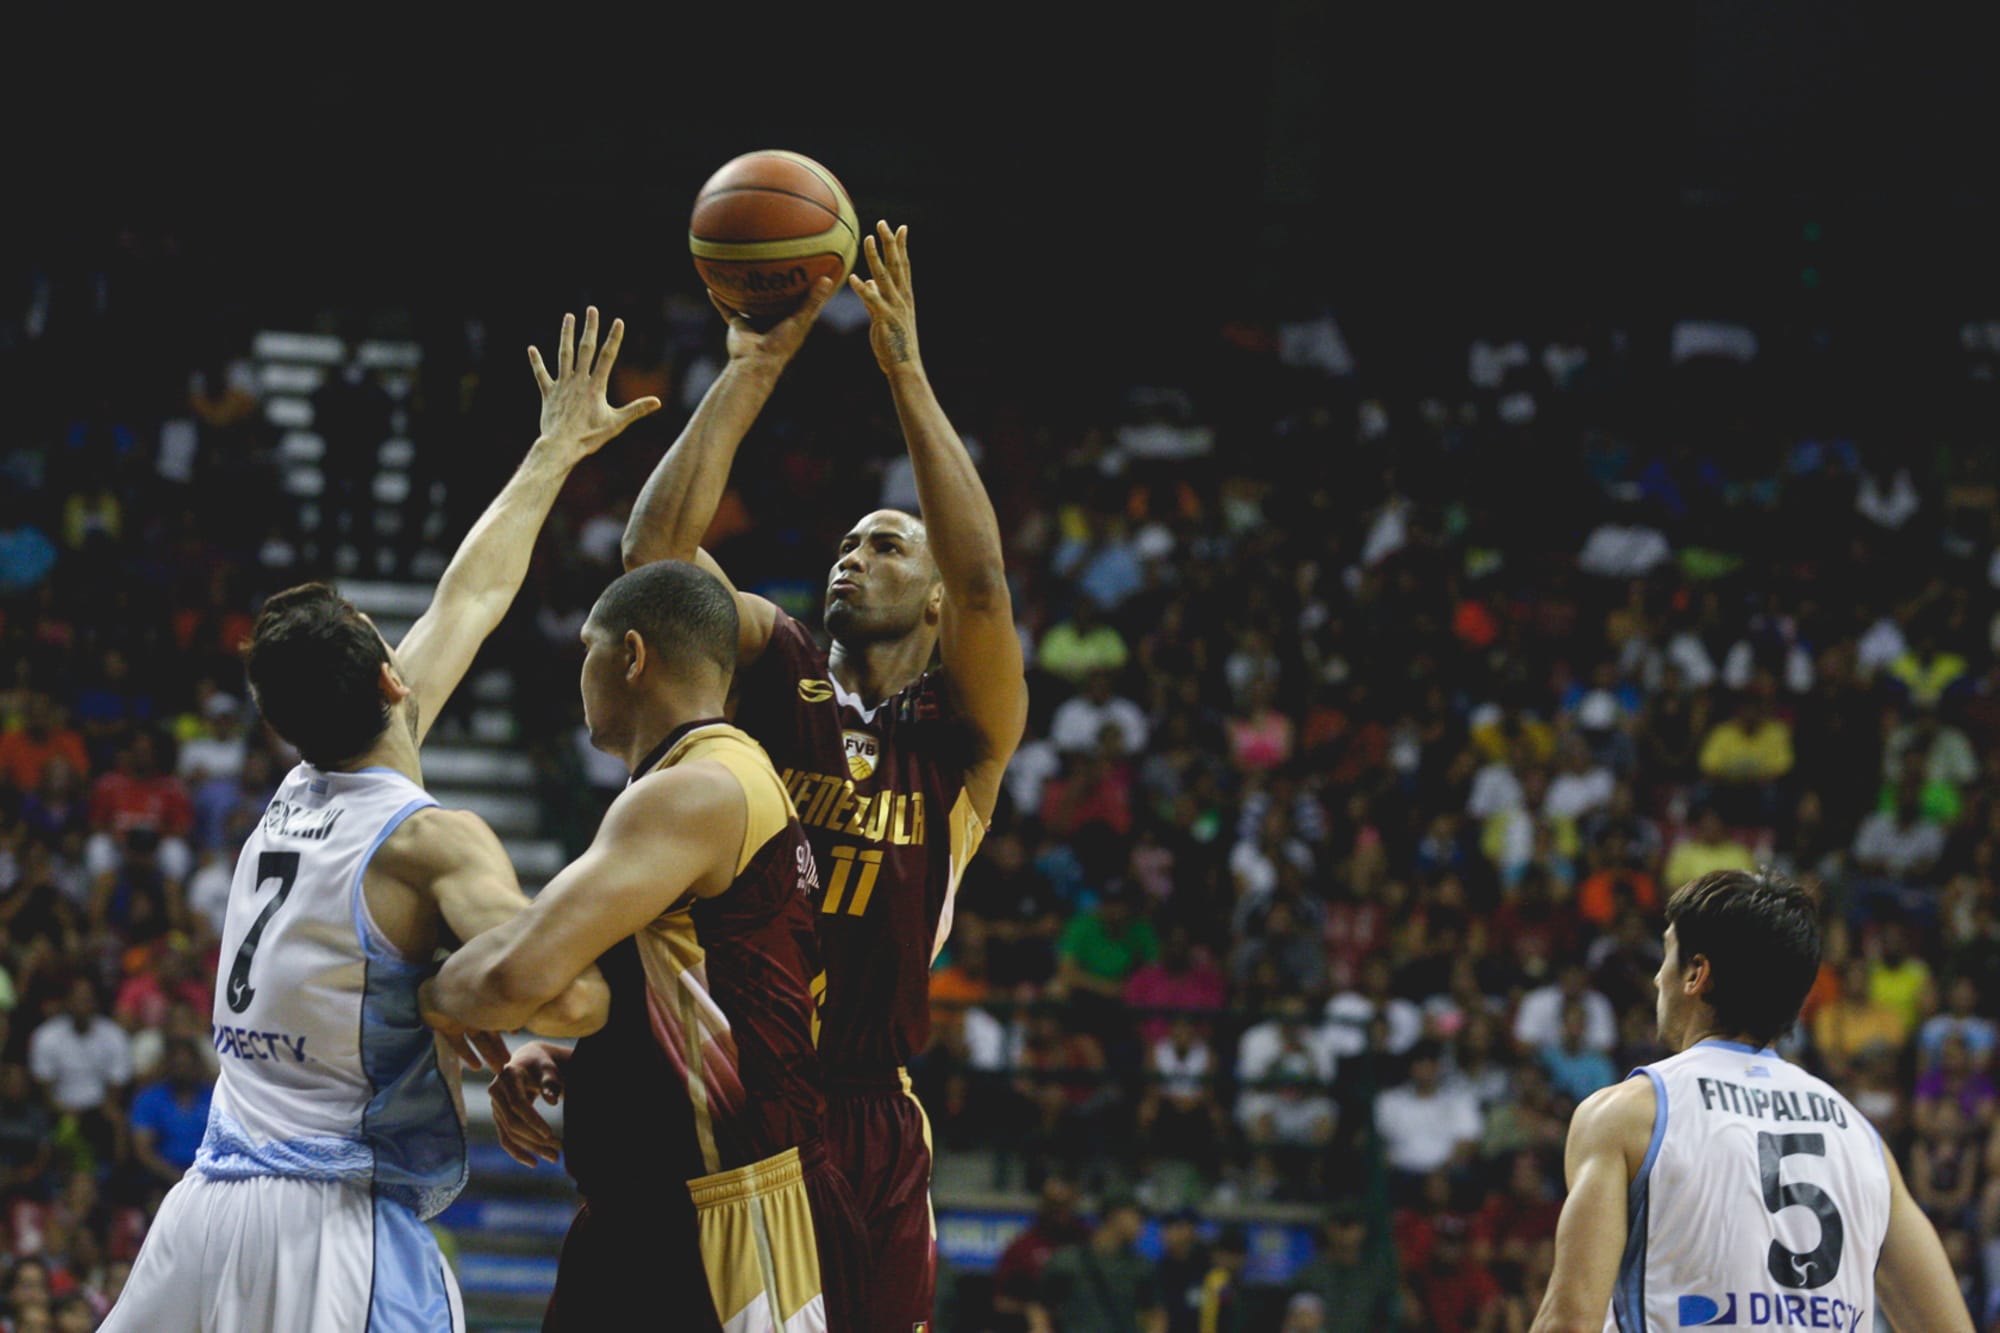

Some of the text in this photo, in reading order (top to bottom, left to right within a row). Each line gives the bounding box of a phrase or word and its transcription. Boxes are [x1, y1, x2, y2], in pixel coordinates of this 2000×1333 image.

[846, 738, 877, 757] FVB
[821, 845, 884, 917] 11
[227, 852, 300, 1014] 7
[1697, 1077, 1848, 1130] FITIPALDO
[1757, 1131, 1844, 1290] 5
